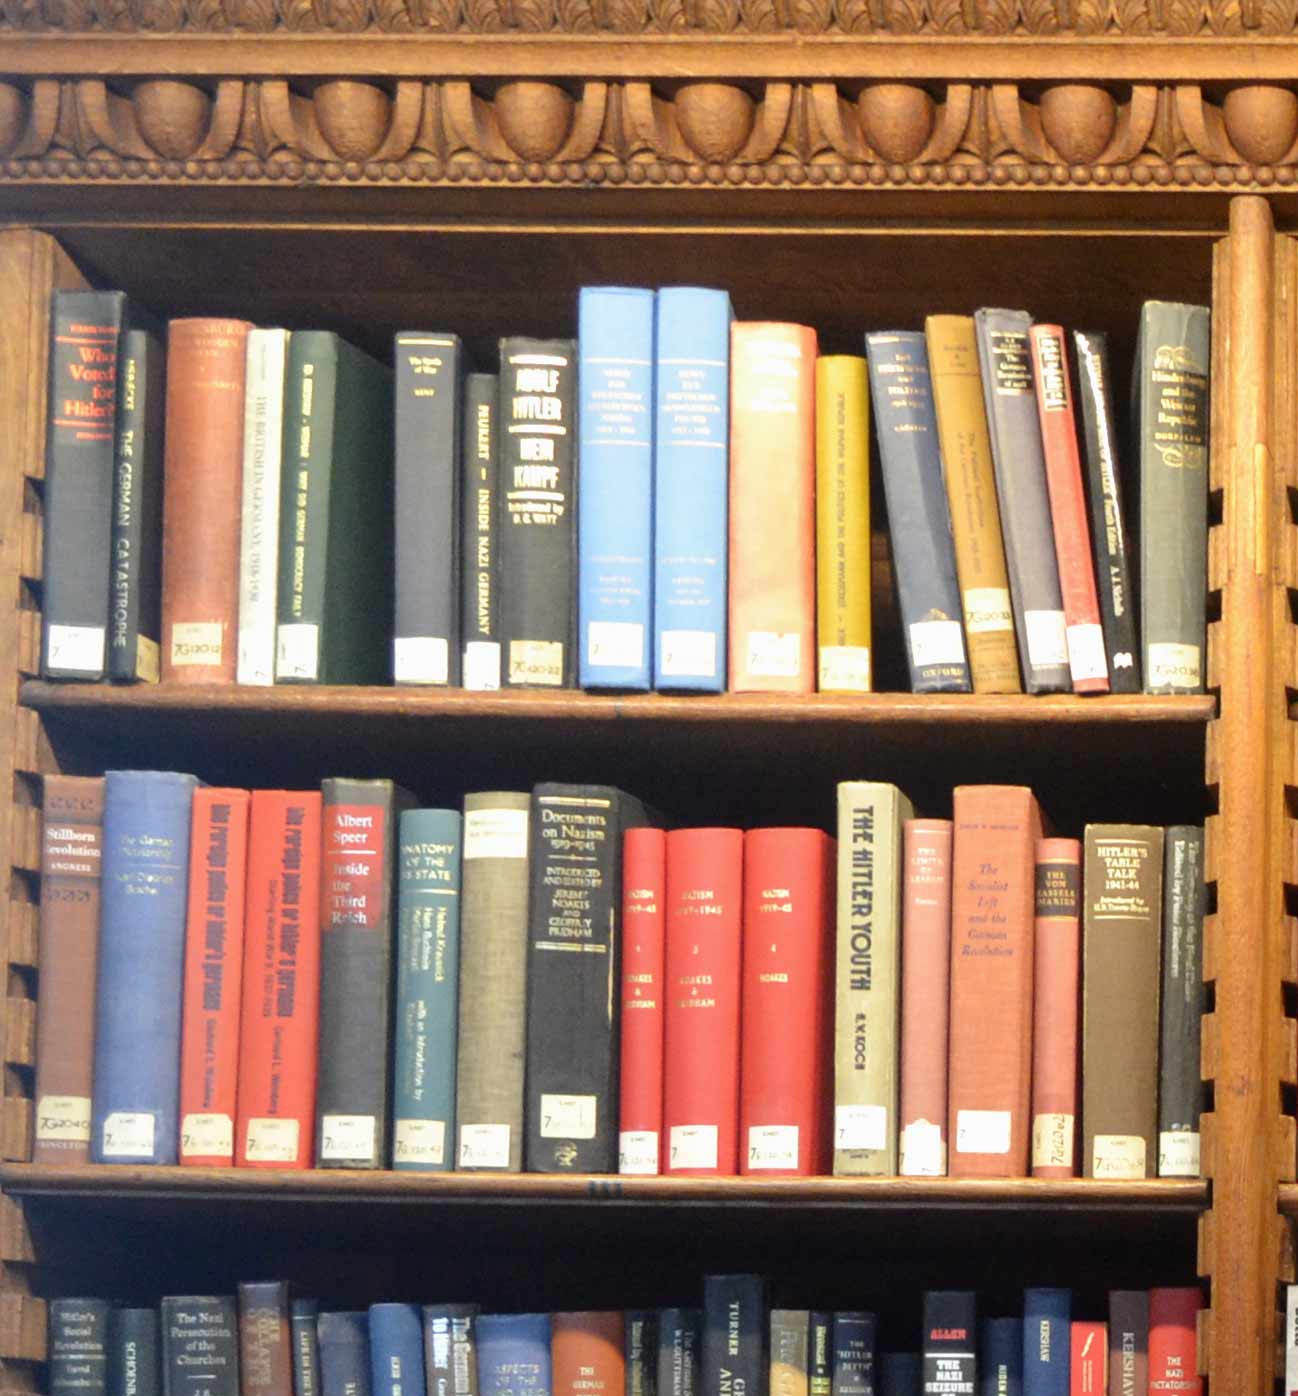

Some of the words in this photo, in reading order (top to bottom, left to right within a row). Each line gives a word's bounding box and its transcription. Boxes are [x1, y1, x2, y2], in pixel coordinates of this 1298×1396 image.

[121, 430, 135, 455] THE
[119, 462, 133, 526] GERMAN
[114, 539, 131, 649] CATASTROPHE
[542, 809, 605, 826] Documents
[851, 805, 874, 843] THE
[543, 827, 557, 839] on
[560, 827, 605, 839] Nazism
[1105, 858, 1140, 868] TABLE
[851, 848, 873, 917] HITLER
[1107, 869, 1136, 879] TALK
[850, 920, 872, 990] YOUTH
[728, 1303, 738, 1355] TURNER
[938, 1360, 960, 1370] THE
[936, 1371, 962, 1381] NAZI
[925, 1383, 973, 1392] SEIZURE
